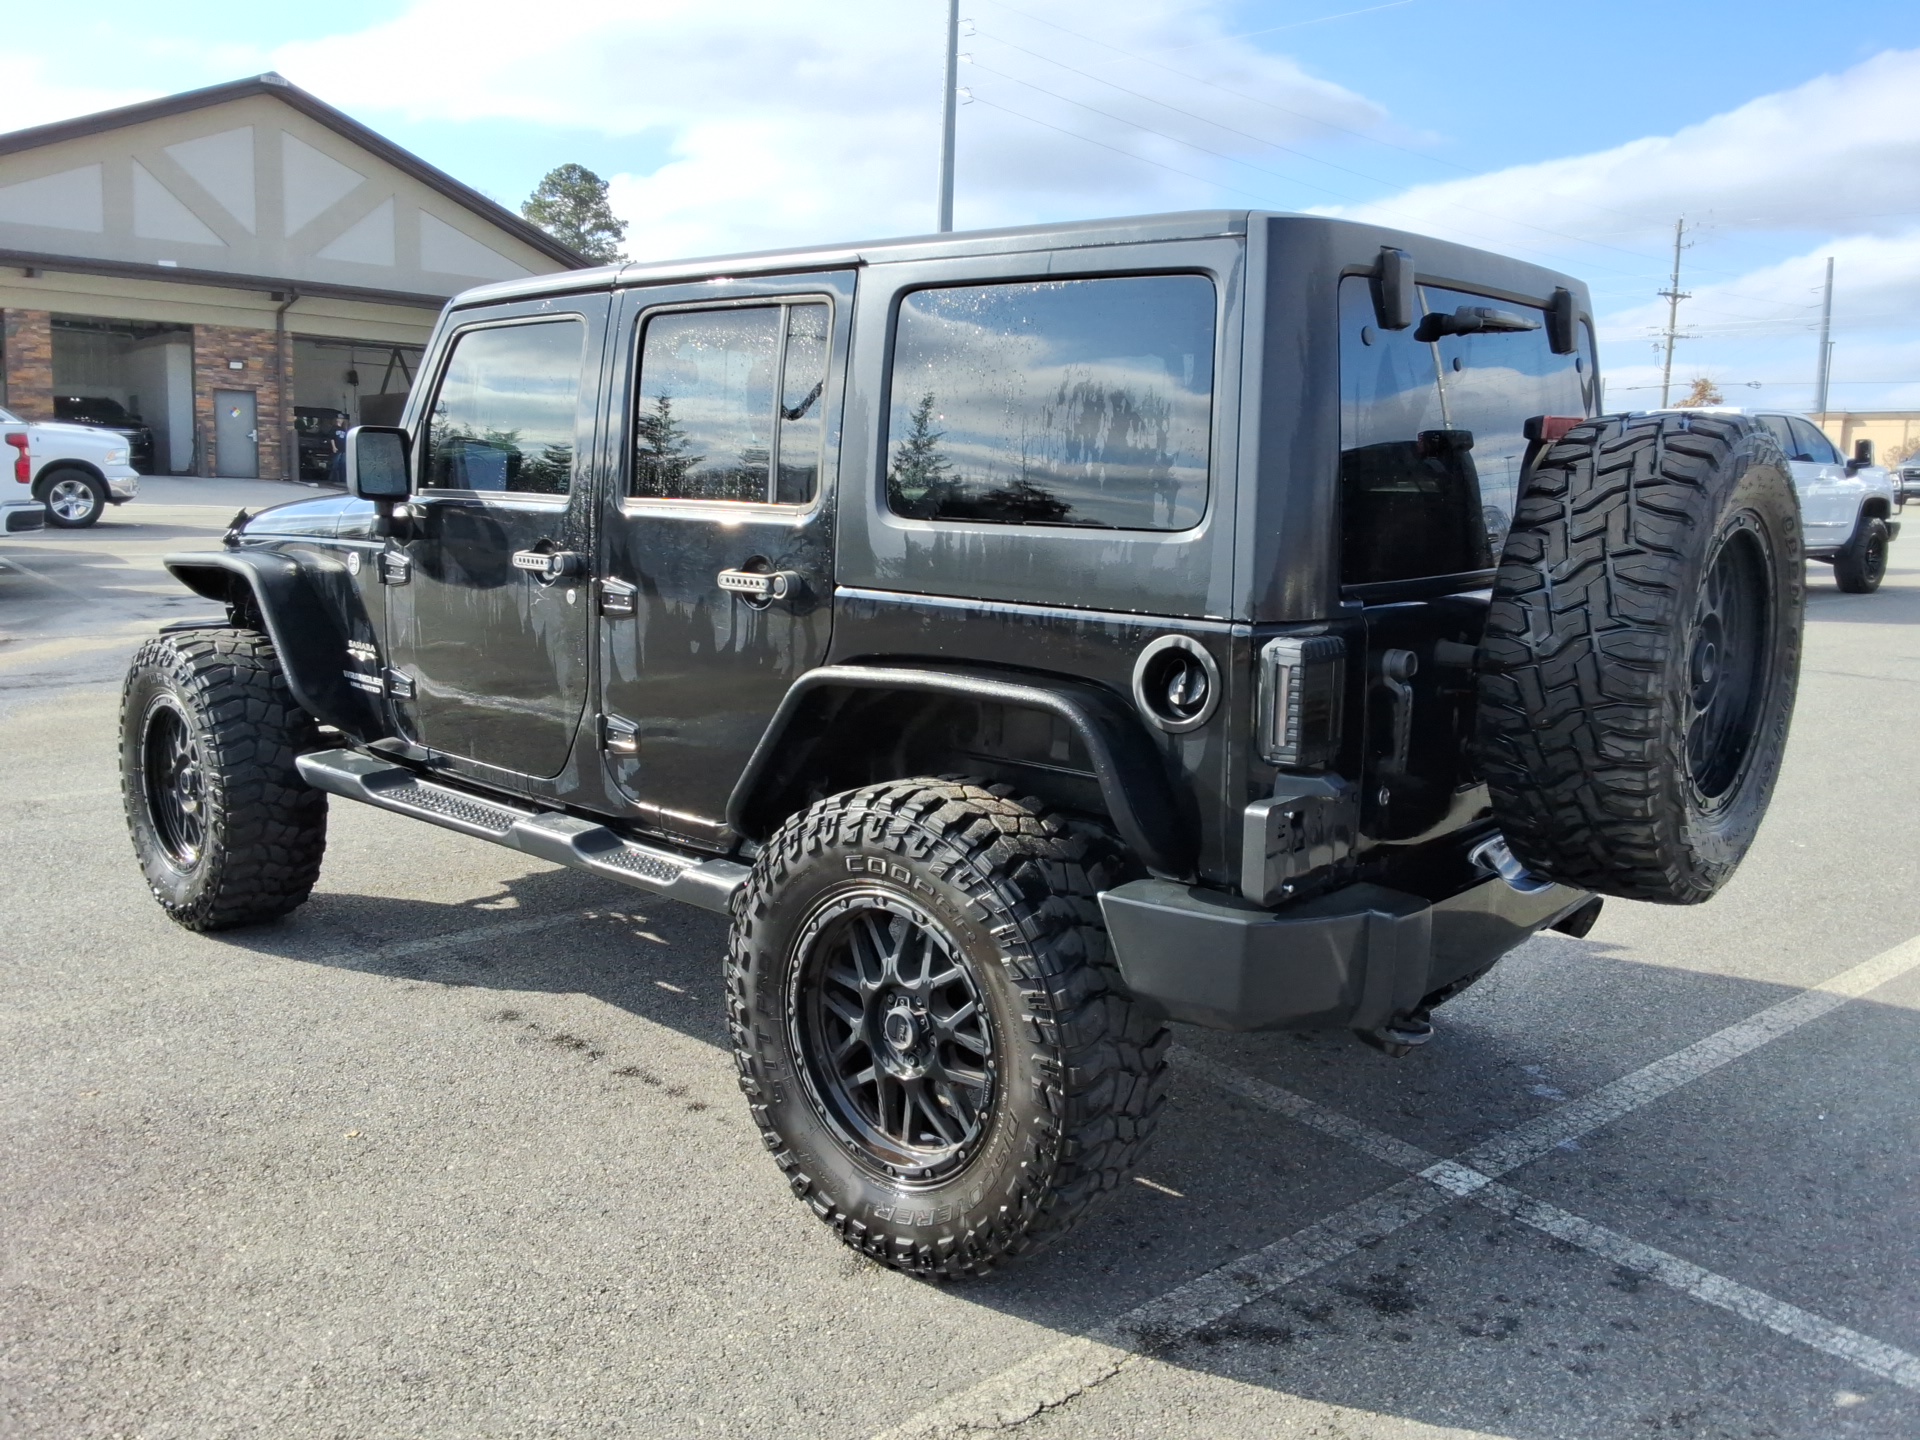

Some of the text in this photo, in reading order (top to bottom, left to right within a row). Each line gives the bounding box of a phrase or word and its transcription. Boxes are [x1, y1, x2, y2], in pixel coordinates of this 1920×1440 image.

[348, 639, 376, 653] SAHARA
[844, 854, 977, 943] COOPER
[873, 1107, 1020, 1228] DISCOVERER
